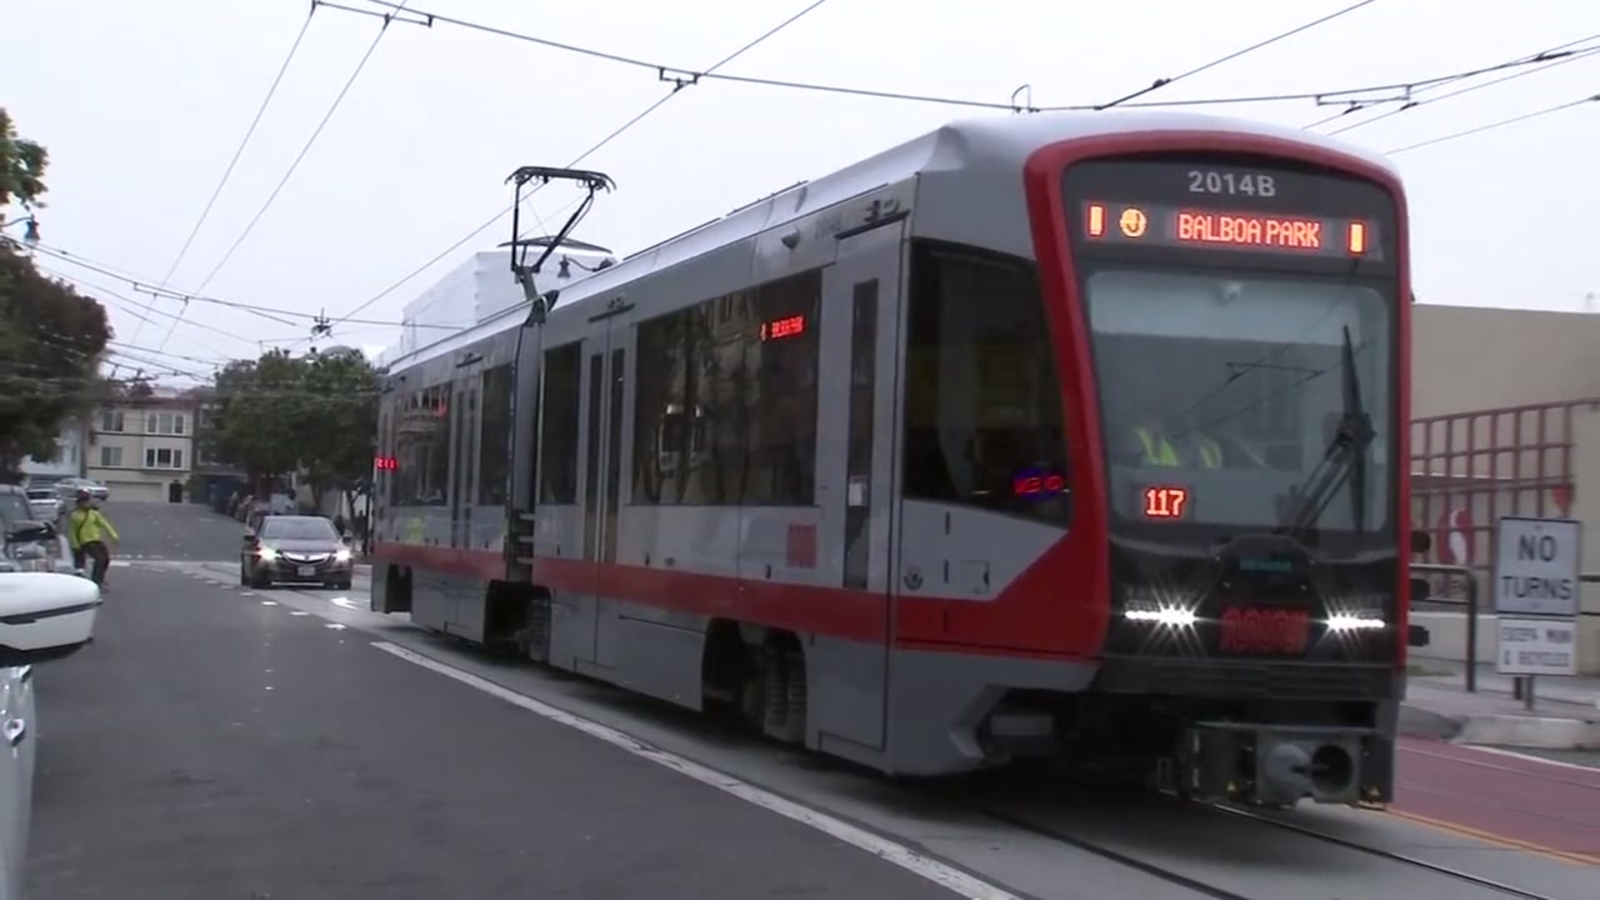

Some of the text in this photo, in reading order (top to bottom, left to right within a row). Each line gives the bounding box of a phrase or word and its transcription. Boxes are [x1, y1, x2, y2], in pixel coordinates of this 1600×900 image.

[1188, 170, 1276, 197] 2014B
[1178, 213, 1261, 244] BALBOA
[1265, 221, 1320, 248] PARK
[1146, 489, 1184, 516] 117
[1518, 535, 1557, 562] NO
[1501, 575, 1571, 600] TURNS
